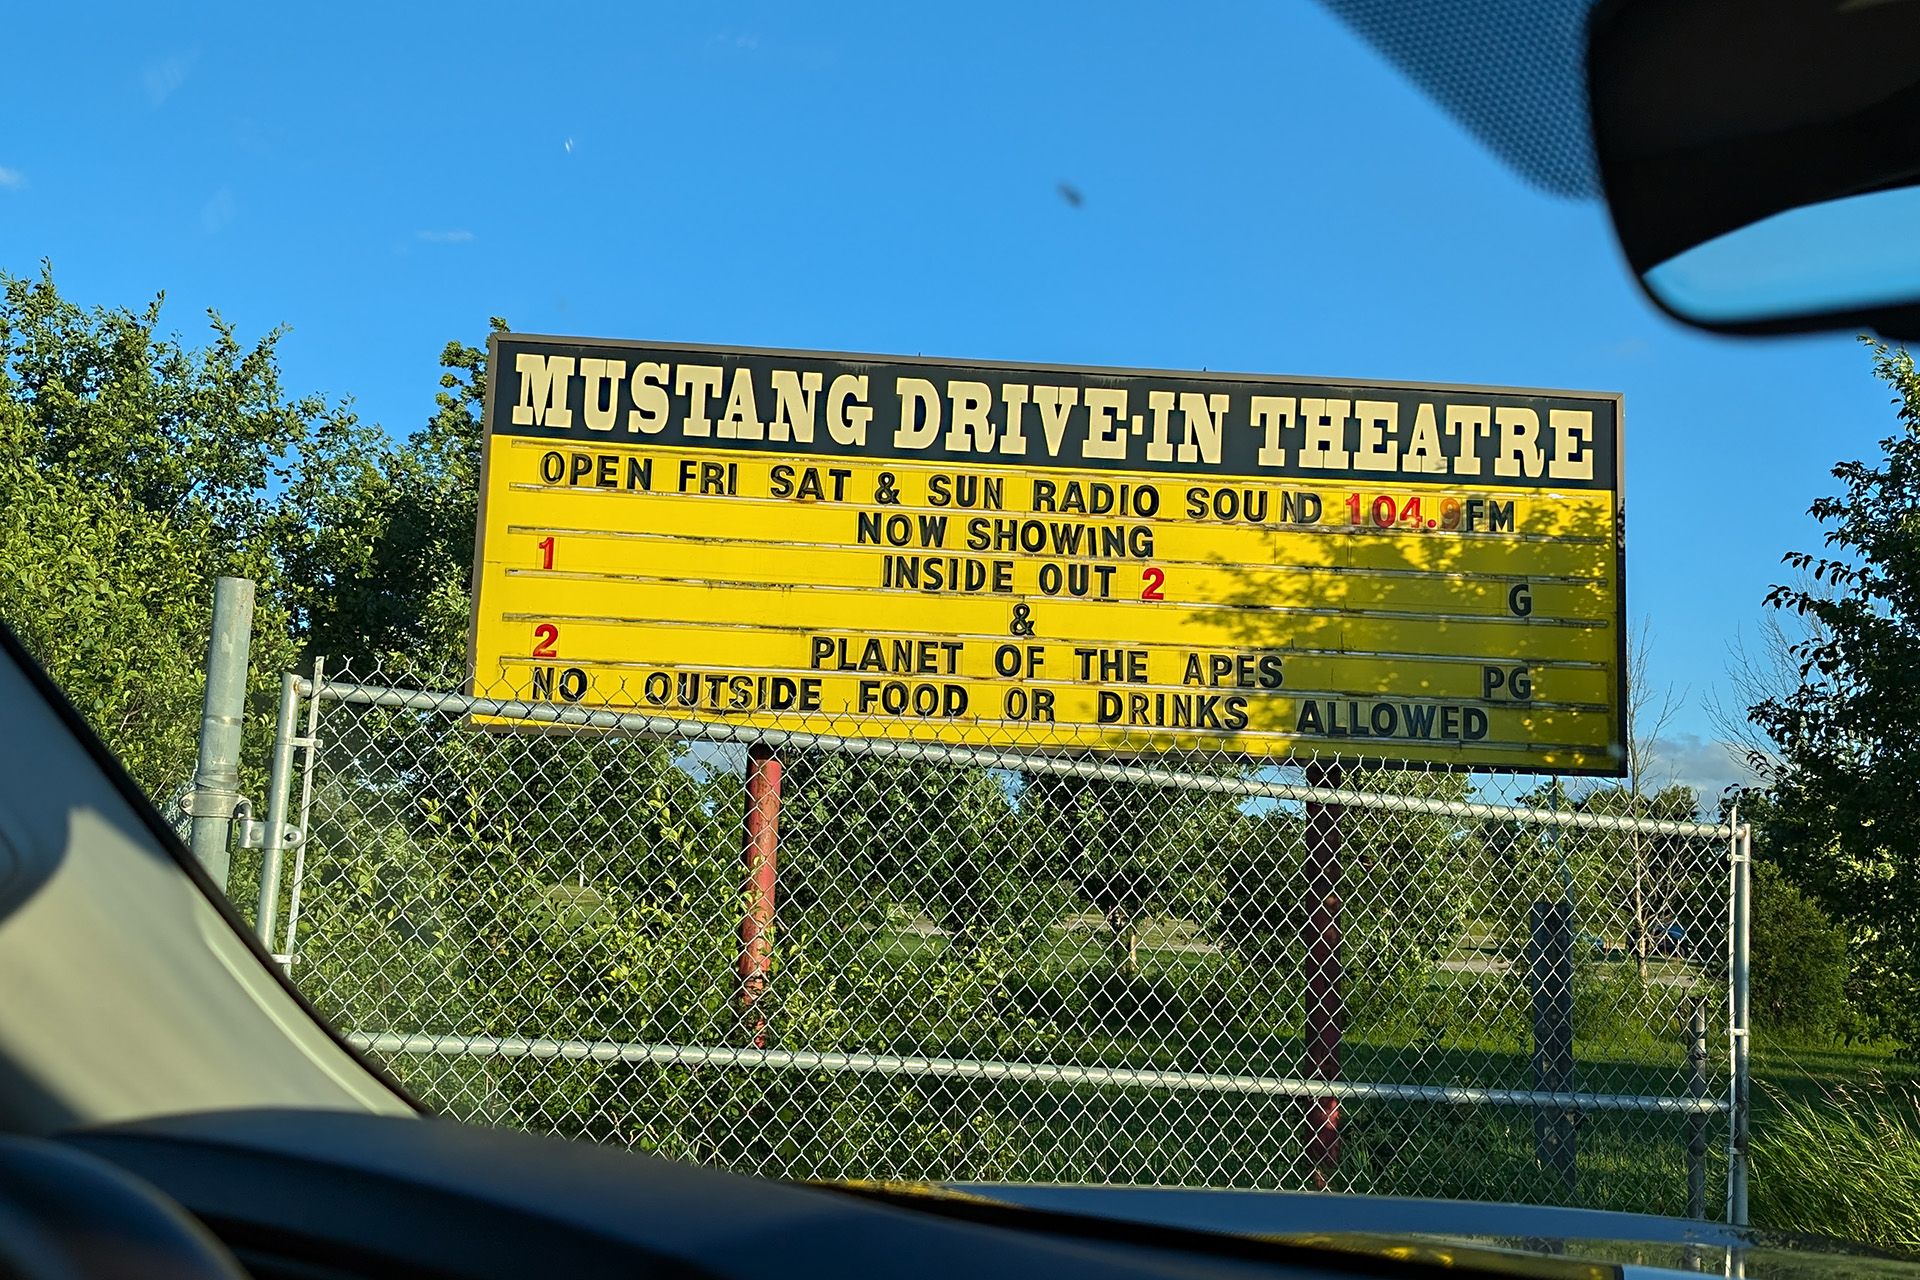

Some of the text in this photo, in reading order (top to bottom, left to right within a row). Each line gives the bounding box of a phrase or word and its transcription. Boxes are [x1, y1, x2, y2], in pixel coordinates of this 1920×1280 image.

[511, 353, 873, 446] MUSTANG
[1250, 396, 1594, 480] THEATRE
[540, 451, 653, 491] OPEN
[678, 460, 738, 496] FRI
[770, 465, 851, 502] SAT
[875, 472, 900, 505] &
[928, 474, 1004, 510] SUN
[1033, 479, 1159, 517] RADIO
[1186, 487, 1322, 524] SOUND
[857, 512, 1154, 558] NOW SHOWING
[538, 537, 1532, 617] 1 INSIDE OUT 2 G
[1010, 603, 1035, 636] &
[532, 623, 1532, 700] 2 PLANET OF THE APES PG
[532, 667, 1489, 740] NO OUTSIDE FOOD OR DRINKS ALLOWED
